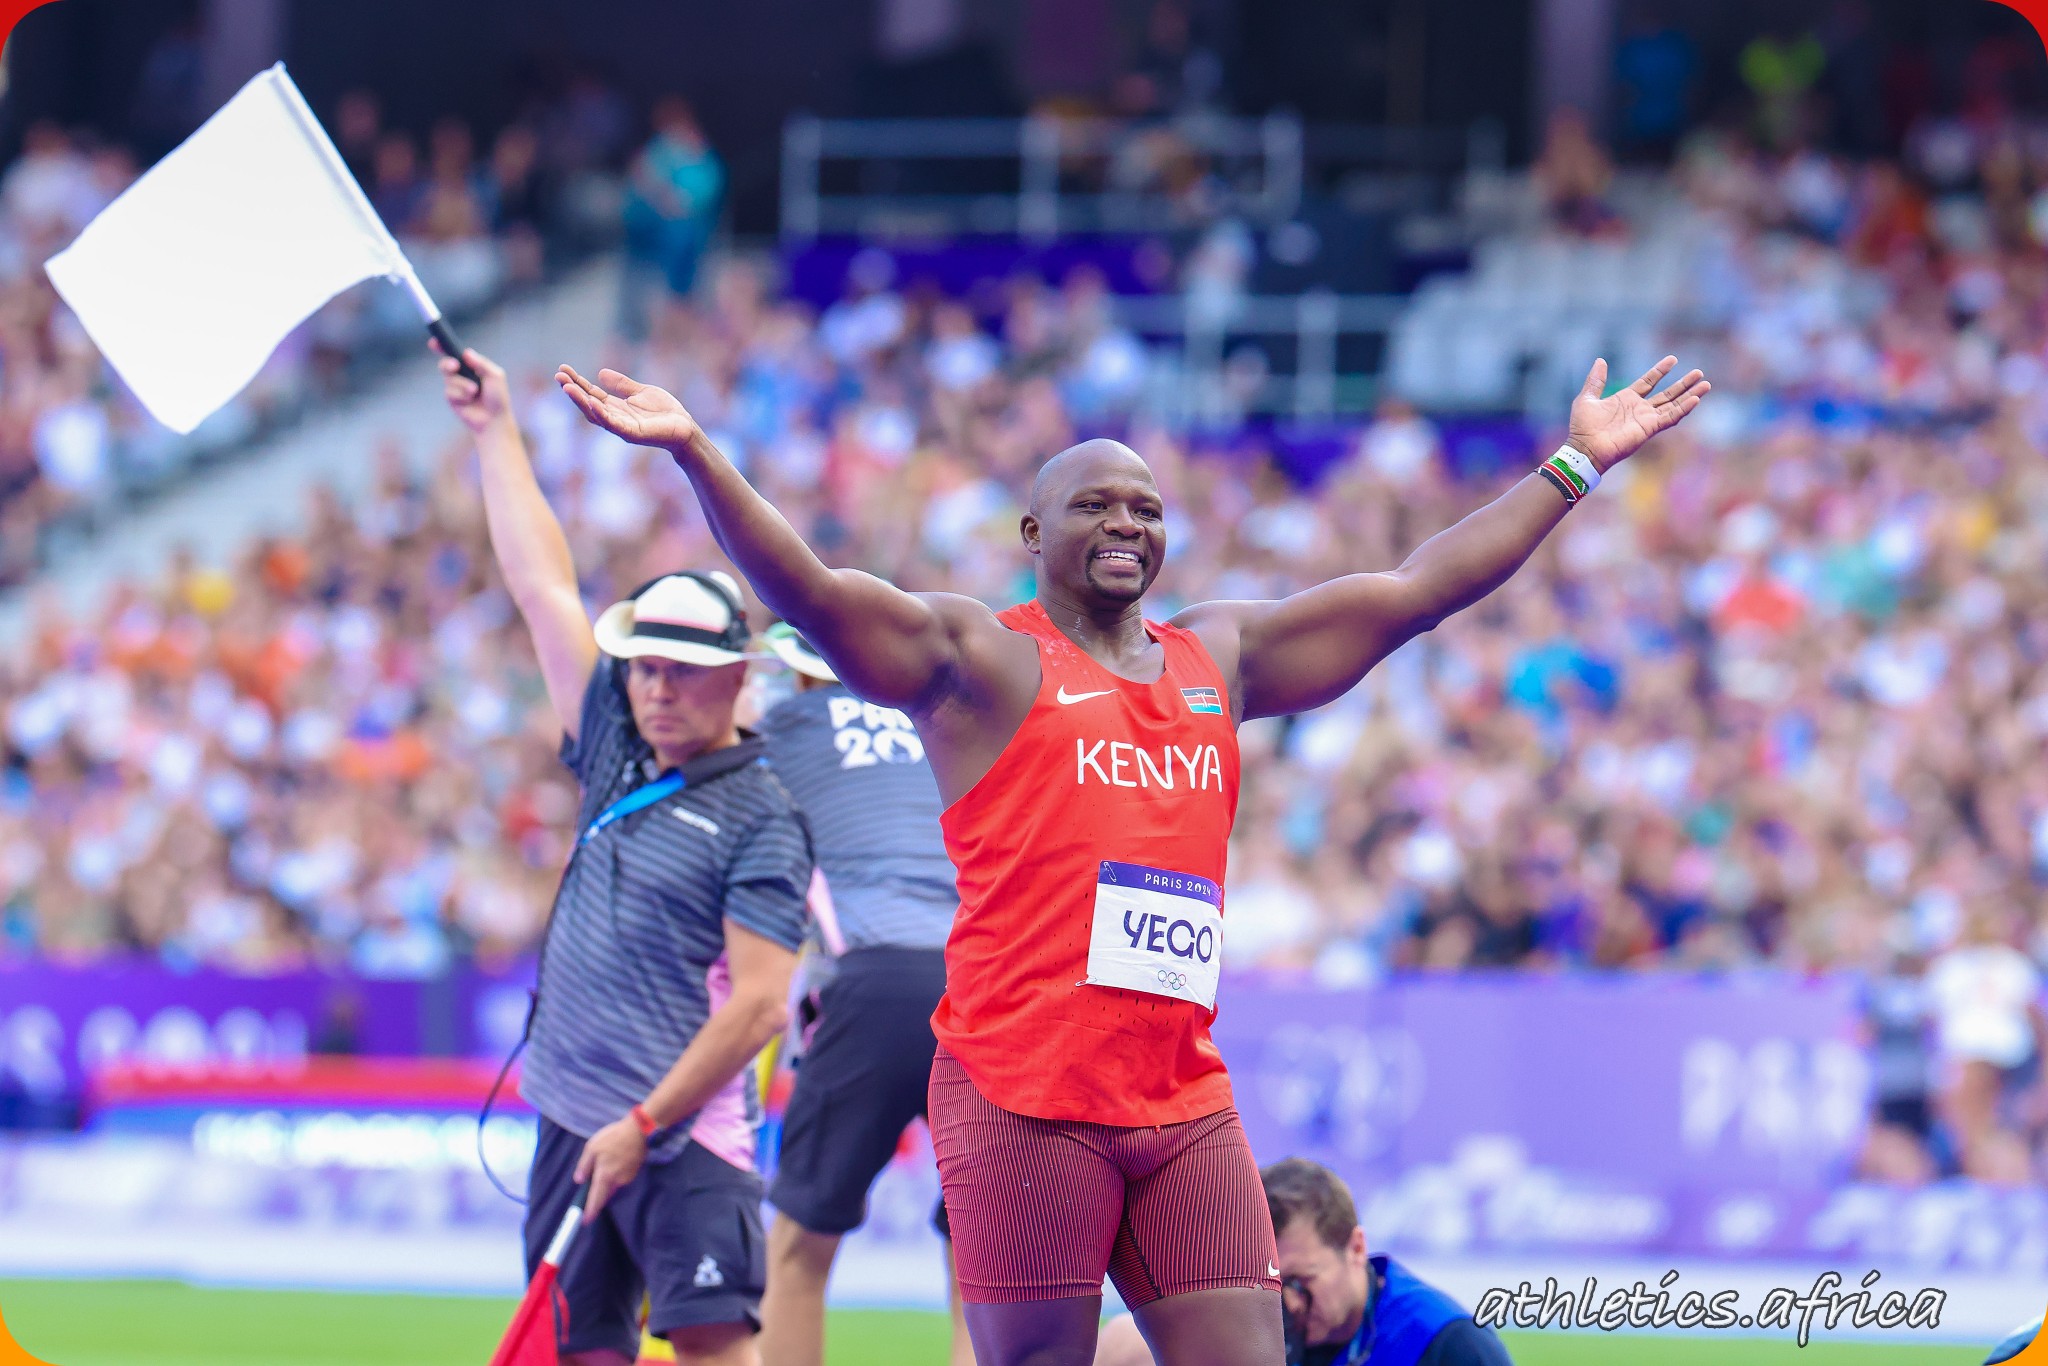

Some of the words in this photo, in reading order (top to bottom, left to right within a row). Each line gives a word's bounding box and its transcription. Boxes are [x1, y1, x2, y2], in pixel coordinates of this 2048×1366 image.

[1077, 738, 1223, 793] KENYA
[1145, 873, 1182, 889] PARIS
[1187, 881, 1211, 897] 2024
[1123, 910, 1213, 964] YEGO
